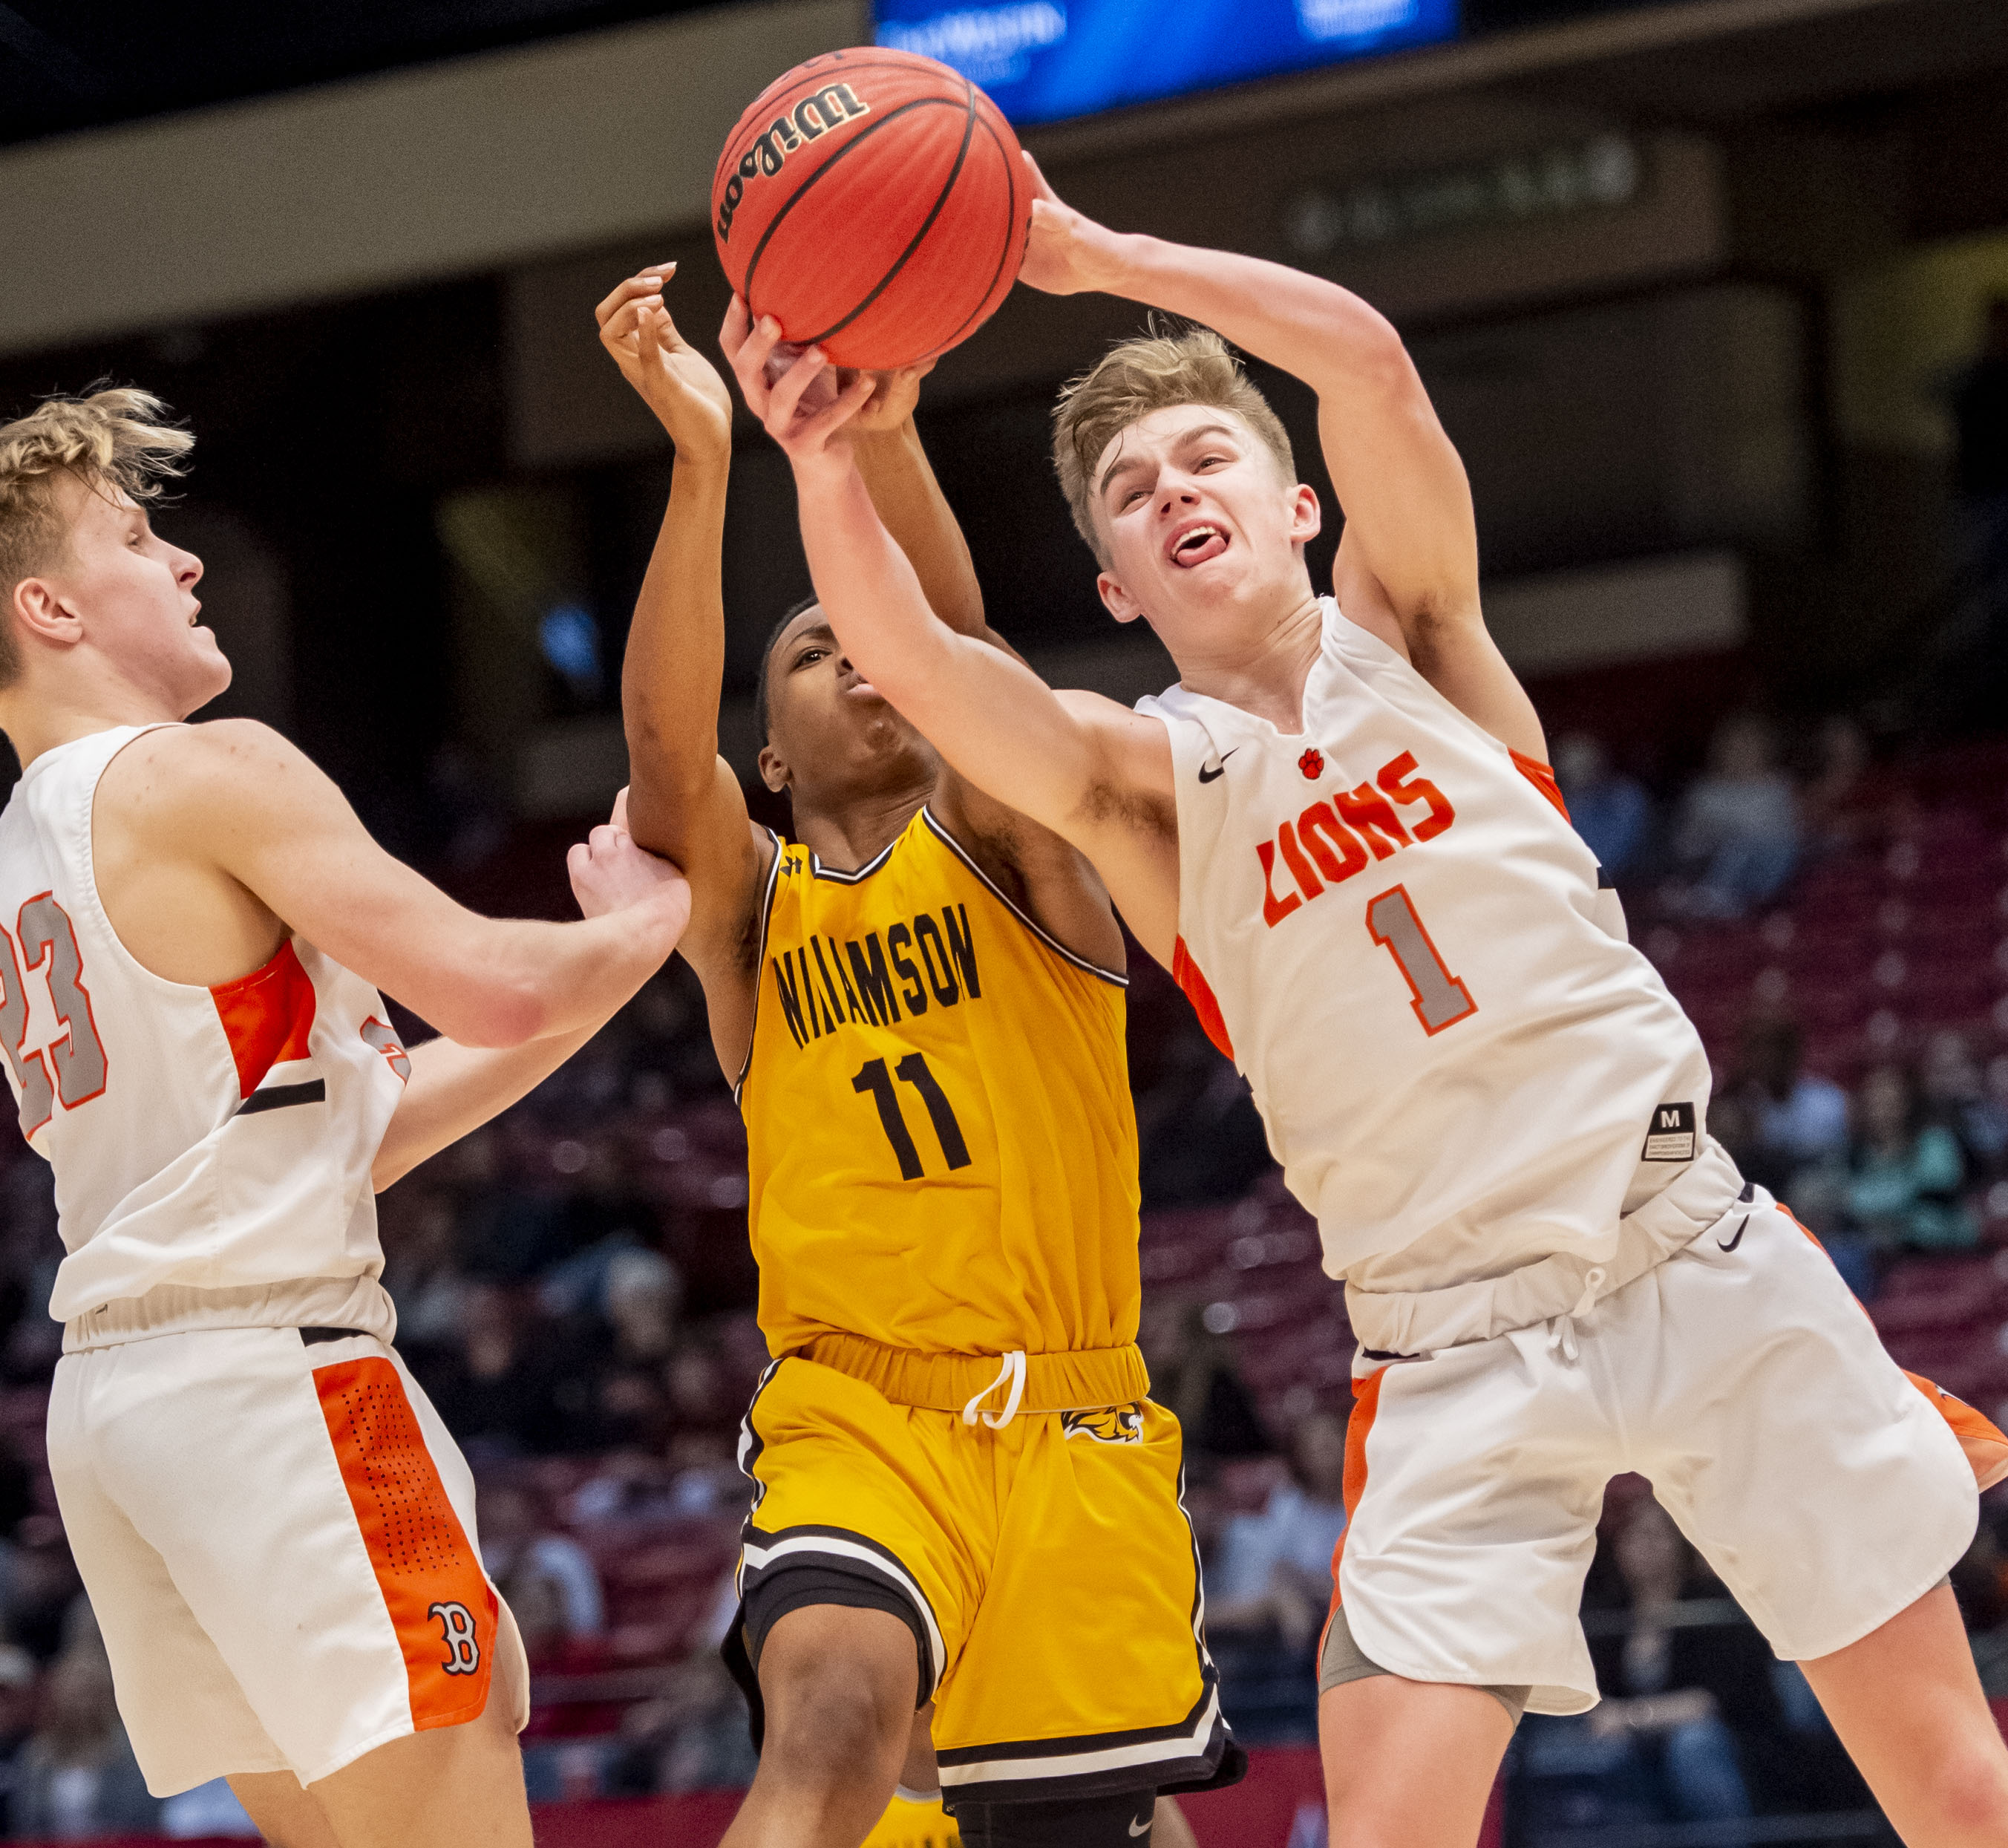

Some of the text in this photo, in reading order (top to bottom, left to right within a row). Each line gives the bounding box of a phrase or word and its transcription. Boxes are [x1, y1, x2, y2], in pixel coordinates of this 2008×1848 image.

[717, 82, 871, 244] Wilson
[1256, 750, 1456, 929] LIONS
[773, 903, 981, 1051] WIIAMSON
[1365, 883, 1479, 1037] 1
[851, 1052, 972, 1181] 11
[1661, 1110, 1681, 1128] M
[428, 1601, 480, 1676] B
